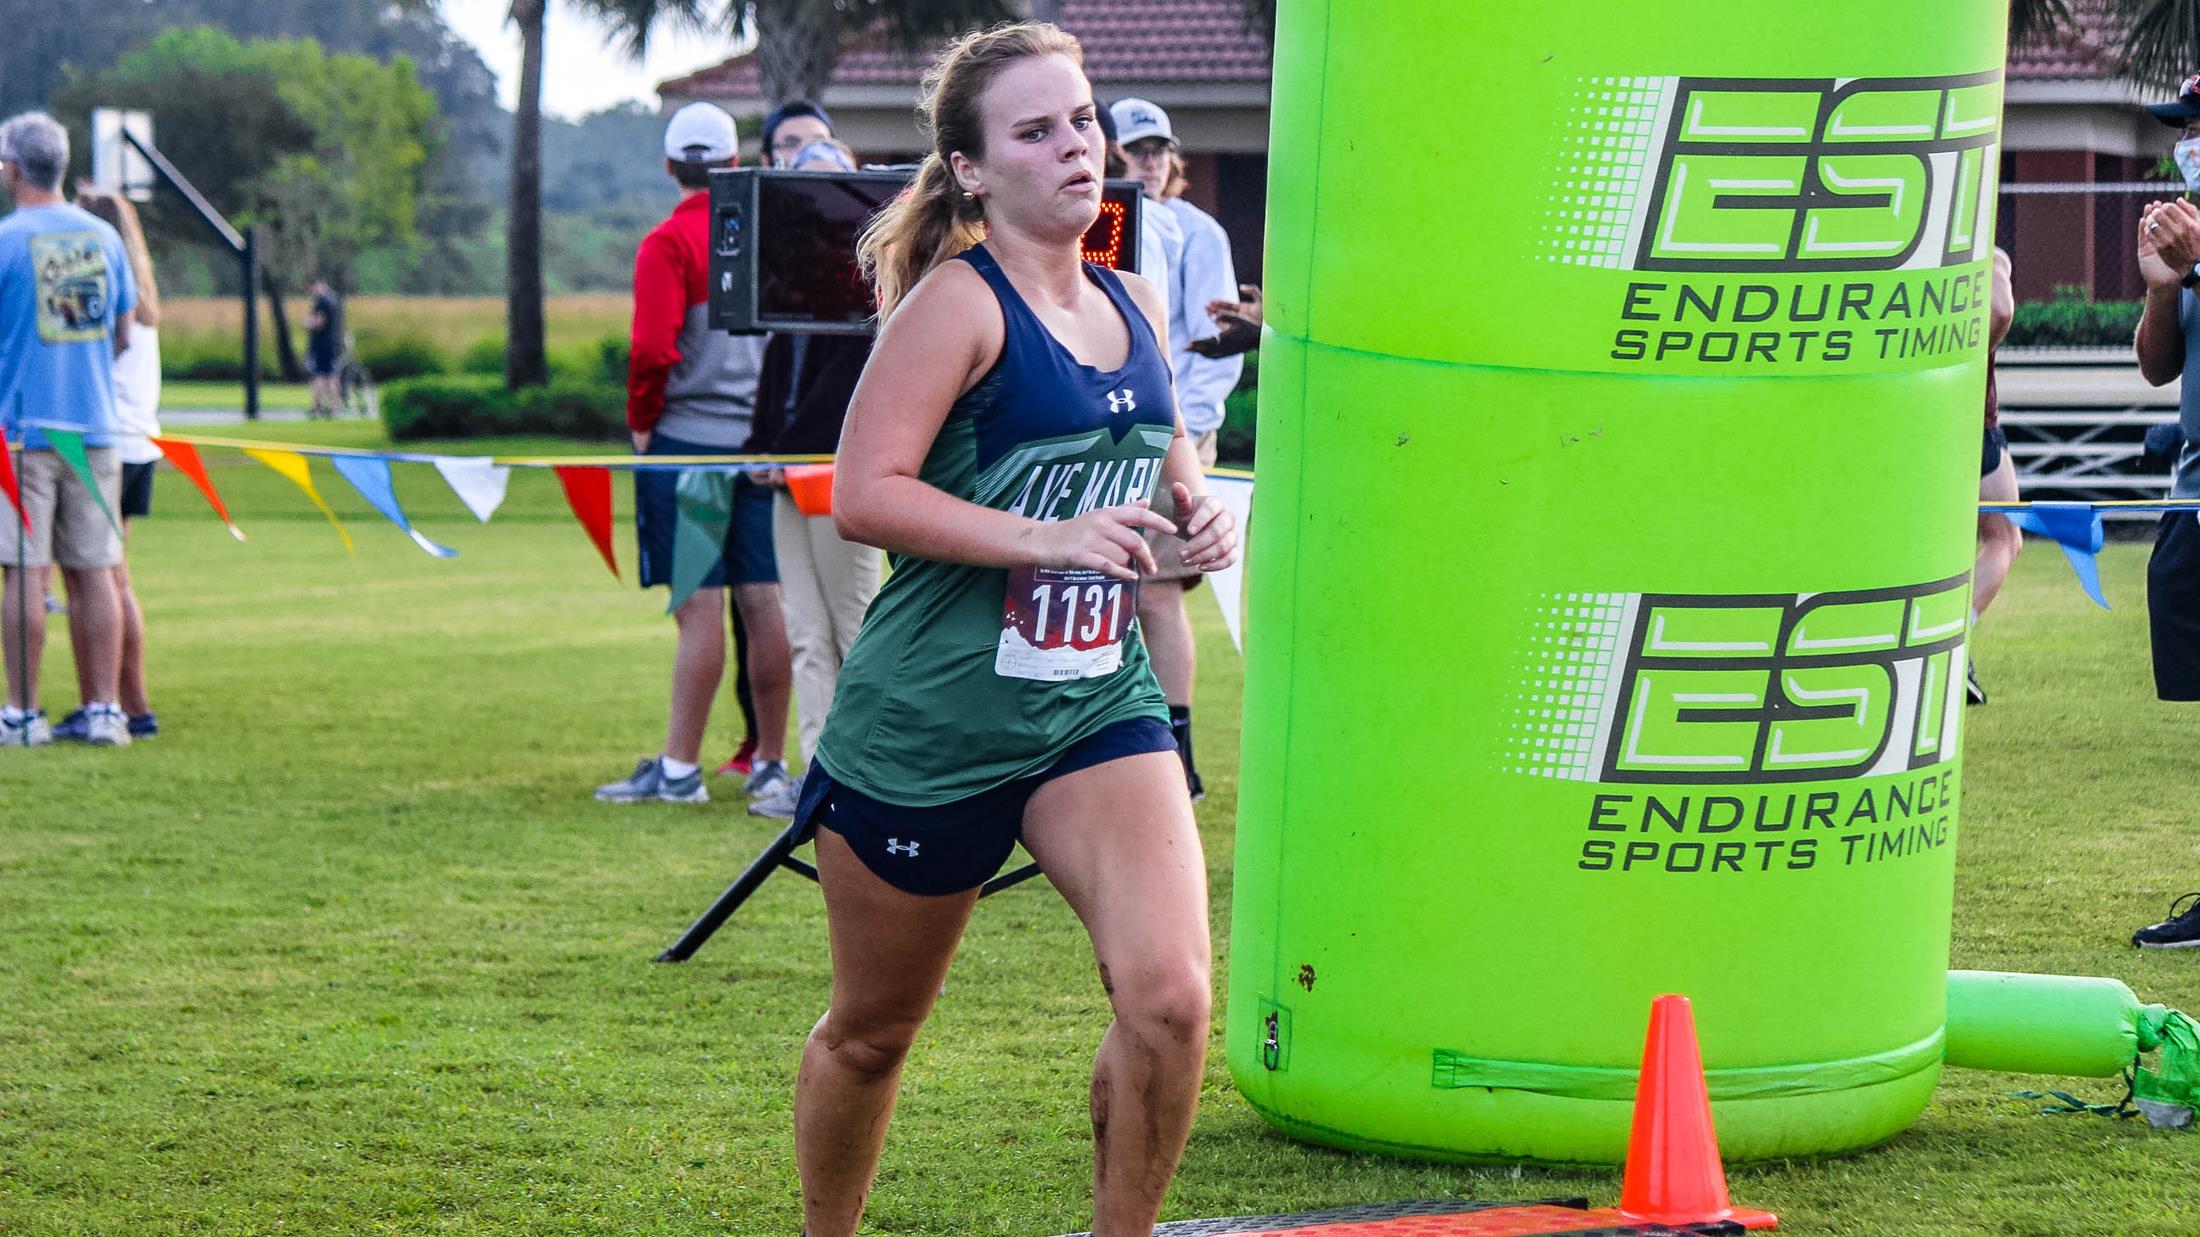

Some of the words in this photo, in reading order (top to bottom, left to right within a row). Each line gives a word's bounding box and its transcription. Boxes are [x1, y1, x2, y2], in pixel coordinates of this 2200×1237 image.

[1621, 271, 1984, 322] ENDURANCE
[1610, 329, 1853, 362] SPORTS
[1875, 317, 1983, 359] TIMING
[1032, 583, 1122, 643] 1131
[1588, 769, 1953, 833] ENDURANCE
[1578, 839, 1817, 872] SPORTS
[1840, 815, 1949, 865] TIMING
